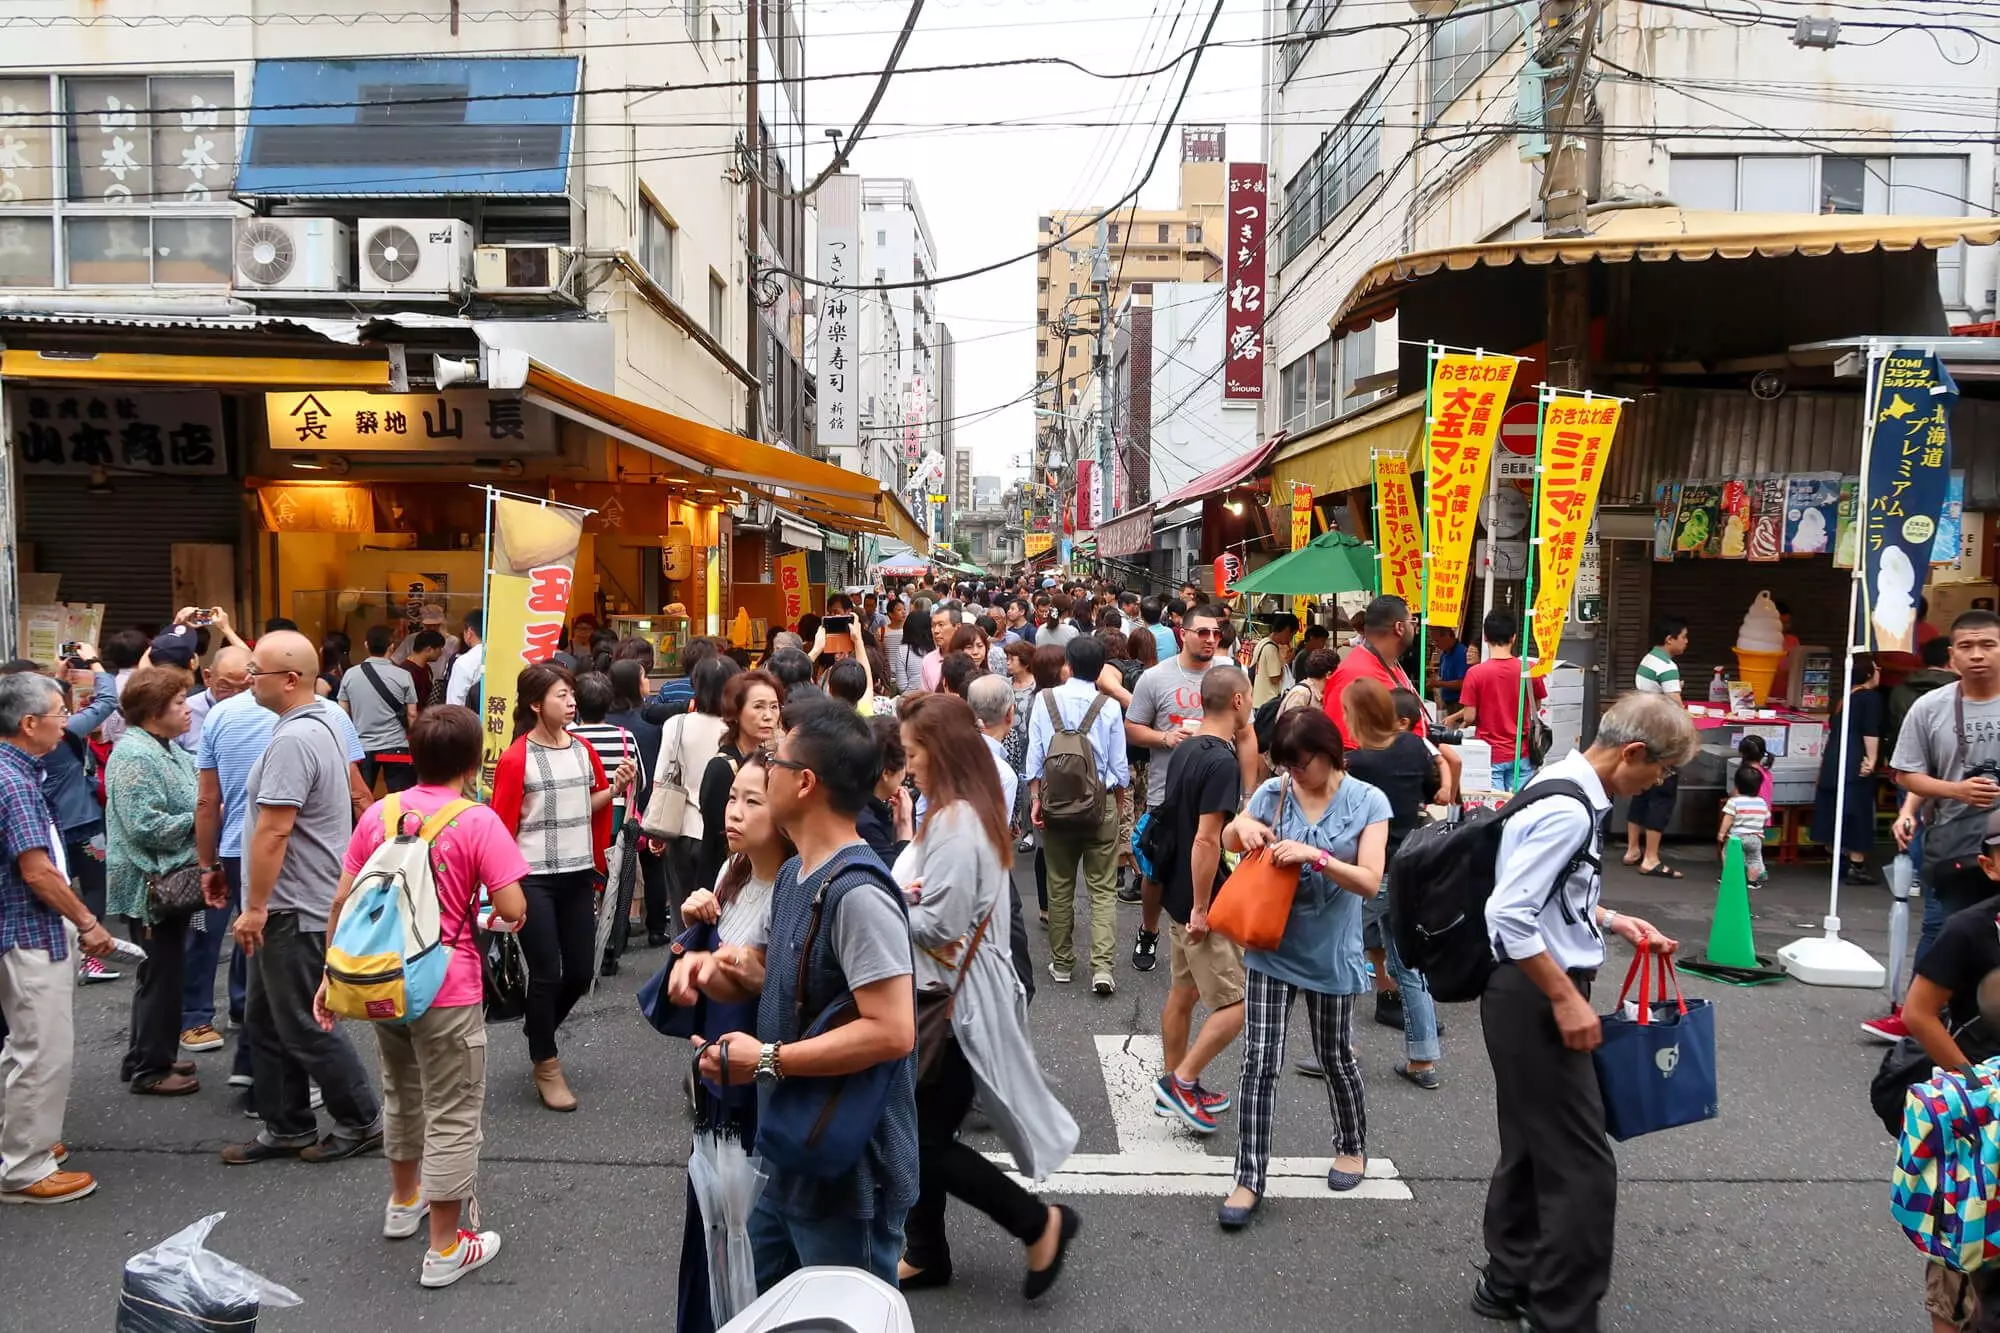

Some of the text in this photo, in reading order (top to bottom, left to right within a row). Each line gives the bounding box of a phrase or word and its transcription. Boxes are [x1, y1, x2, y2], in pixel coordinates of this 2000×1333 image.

[1439, 364, 1512, 382] おきなわ産
[1888, 358, 1922, 369] TOMI
[355, 411, 407, 434] 築地
[422, 398, 525, 440] 山長
[1467, 392, 1496, 437] 家庭用
[1920, 404, 1945, 468] 北海道
[1432, 387, 1476, 544] 大玉マンゴー
[1458, 446, 1481, 475] 安い
[1886, 417, 1930, 518] プレミアム
[1447, 484, 1472, 543] 美味しい
[487, 696, 507, 734] 築地
